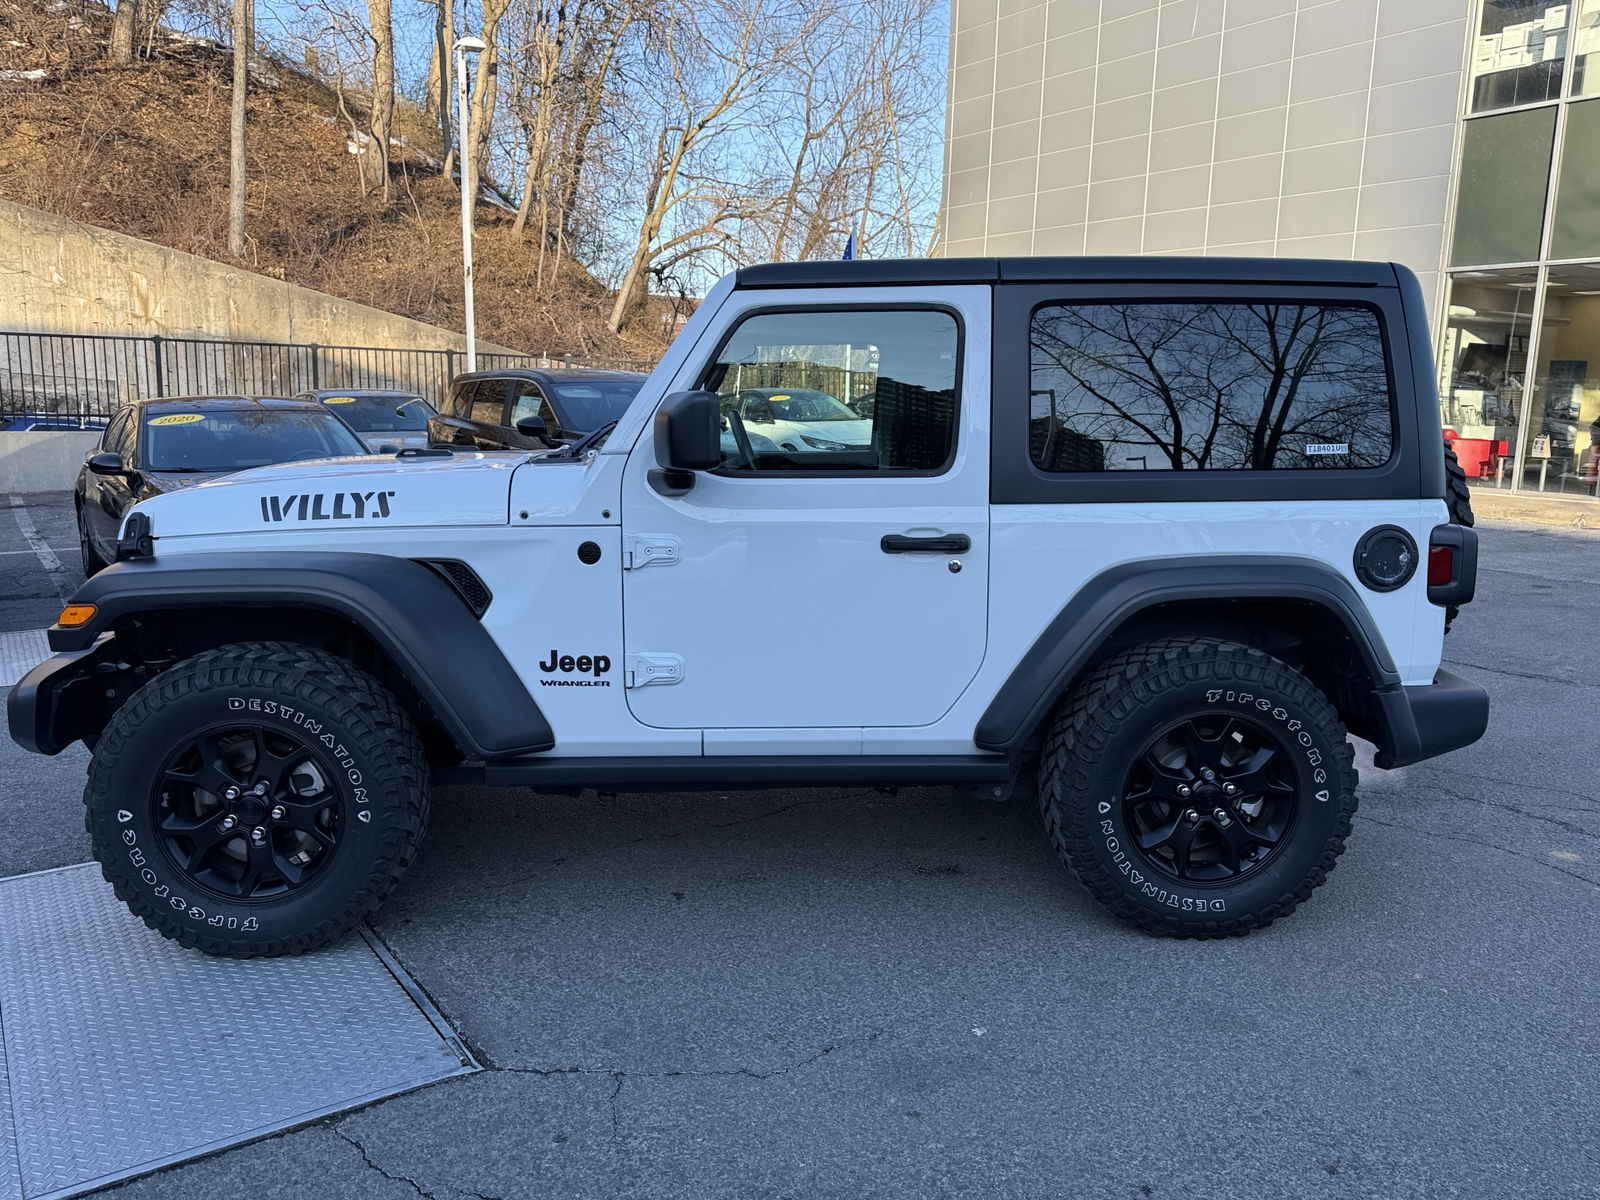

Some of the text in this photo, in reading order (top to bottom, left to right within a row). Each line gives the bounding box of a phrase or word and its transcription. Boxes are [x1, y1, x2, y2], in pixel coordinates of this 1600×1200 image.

[158, 415, 195, 425] 2020
[261, 491, 396, 522] WILLYS
[539, 649, 611, 677] Jeep
[228, 697, 370, 804] DESTINATION
[1206, 689, 1327, 784] Firestone
[122, 829, 260, 932] Firestone
[1100, 818, 1227, 912] DESTINATION
